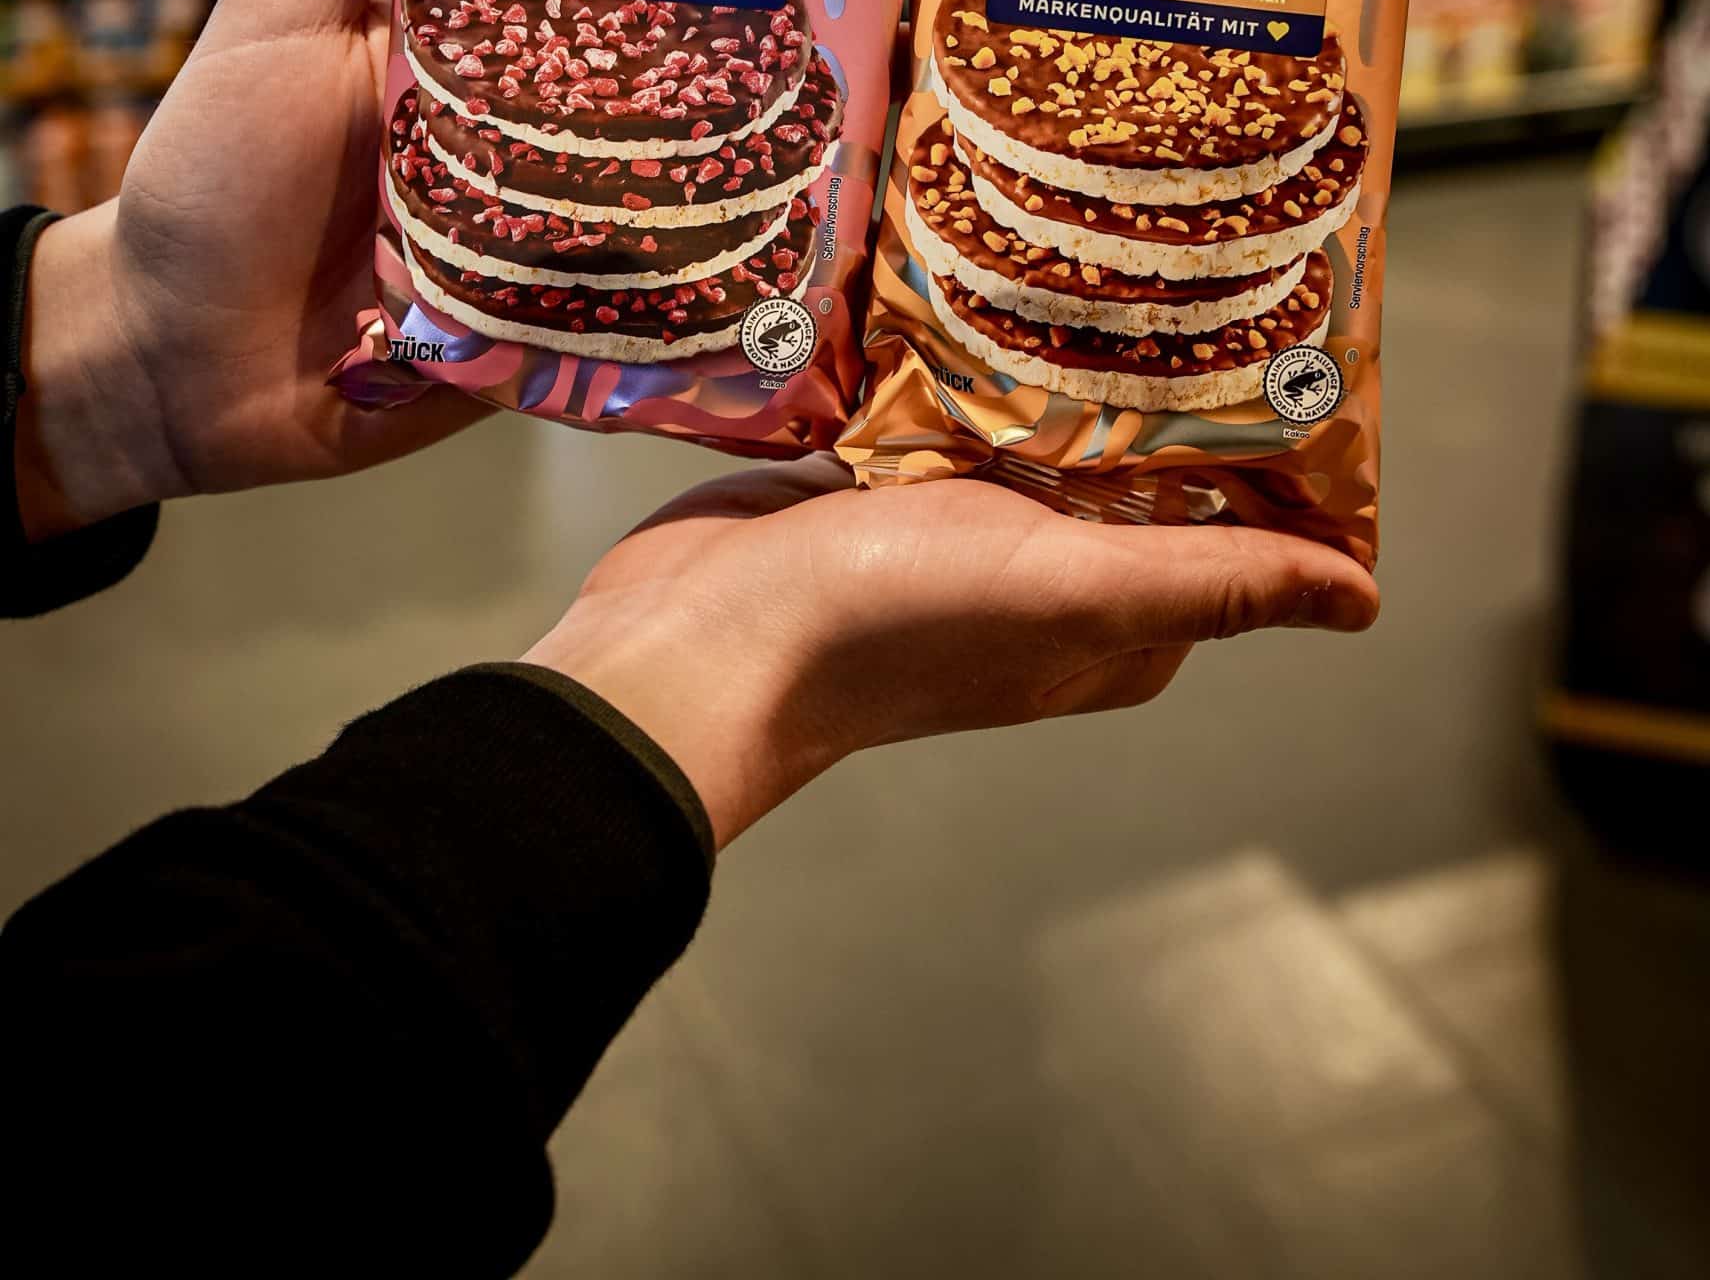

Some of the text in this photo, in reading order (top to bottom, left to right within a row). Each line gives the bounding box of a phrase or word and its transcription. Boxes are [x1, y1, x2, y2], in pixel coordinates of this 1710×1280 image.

[1221, 19, 1260, 37] MIT
[822, 177, 842, 260] Serviervorschlag
[1350, 226, 1371, 310] Serviervorschlag
[1284, 429, 1310, 439] Kakao
